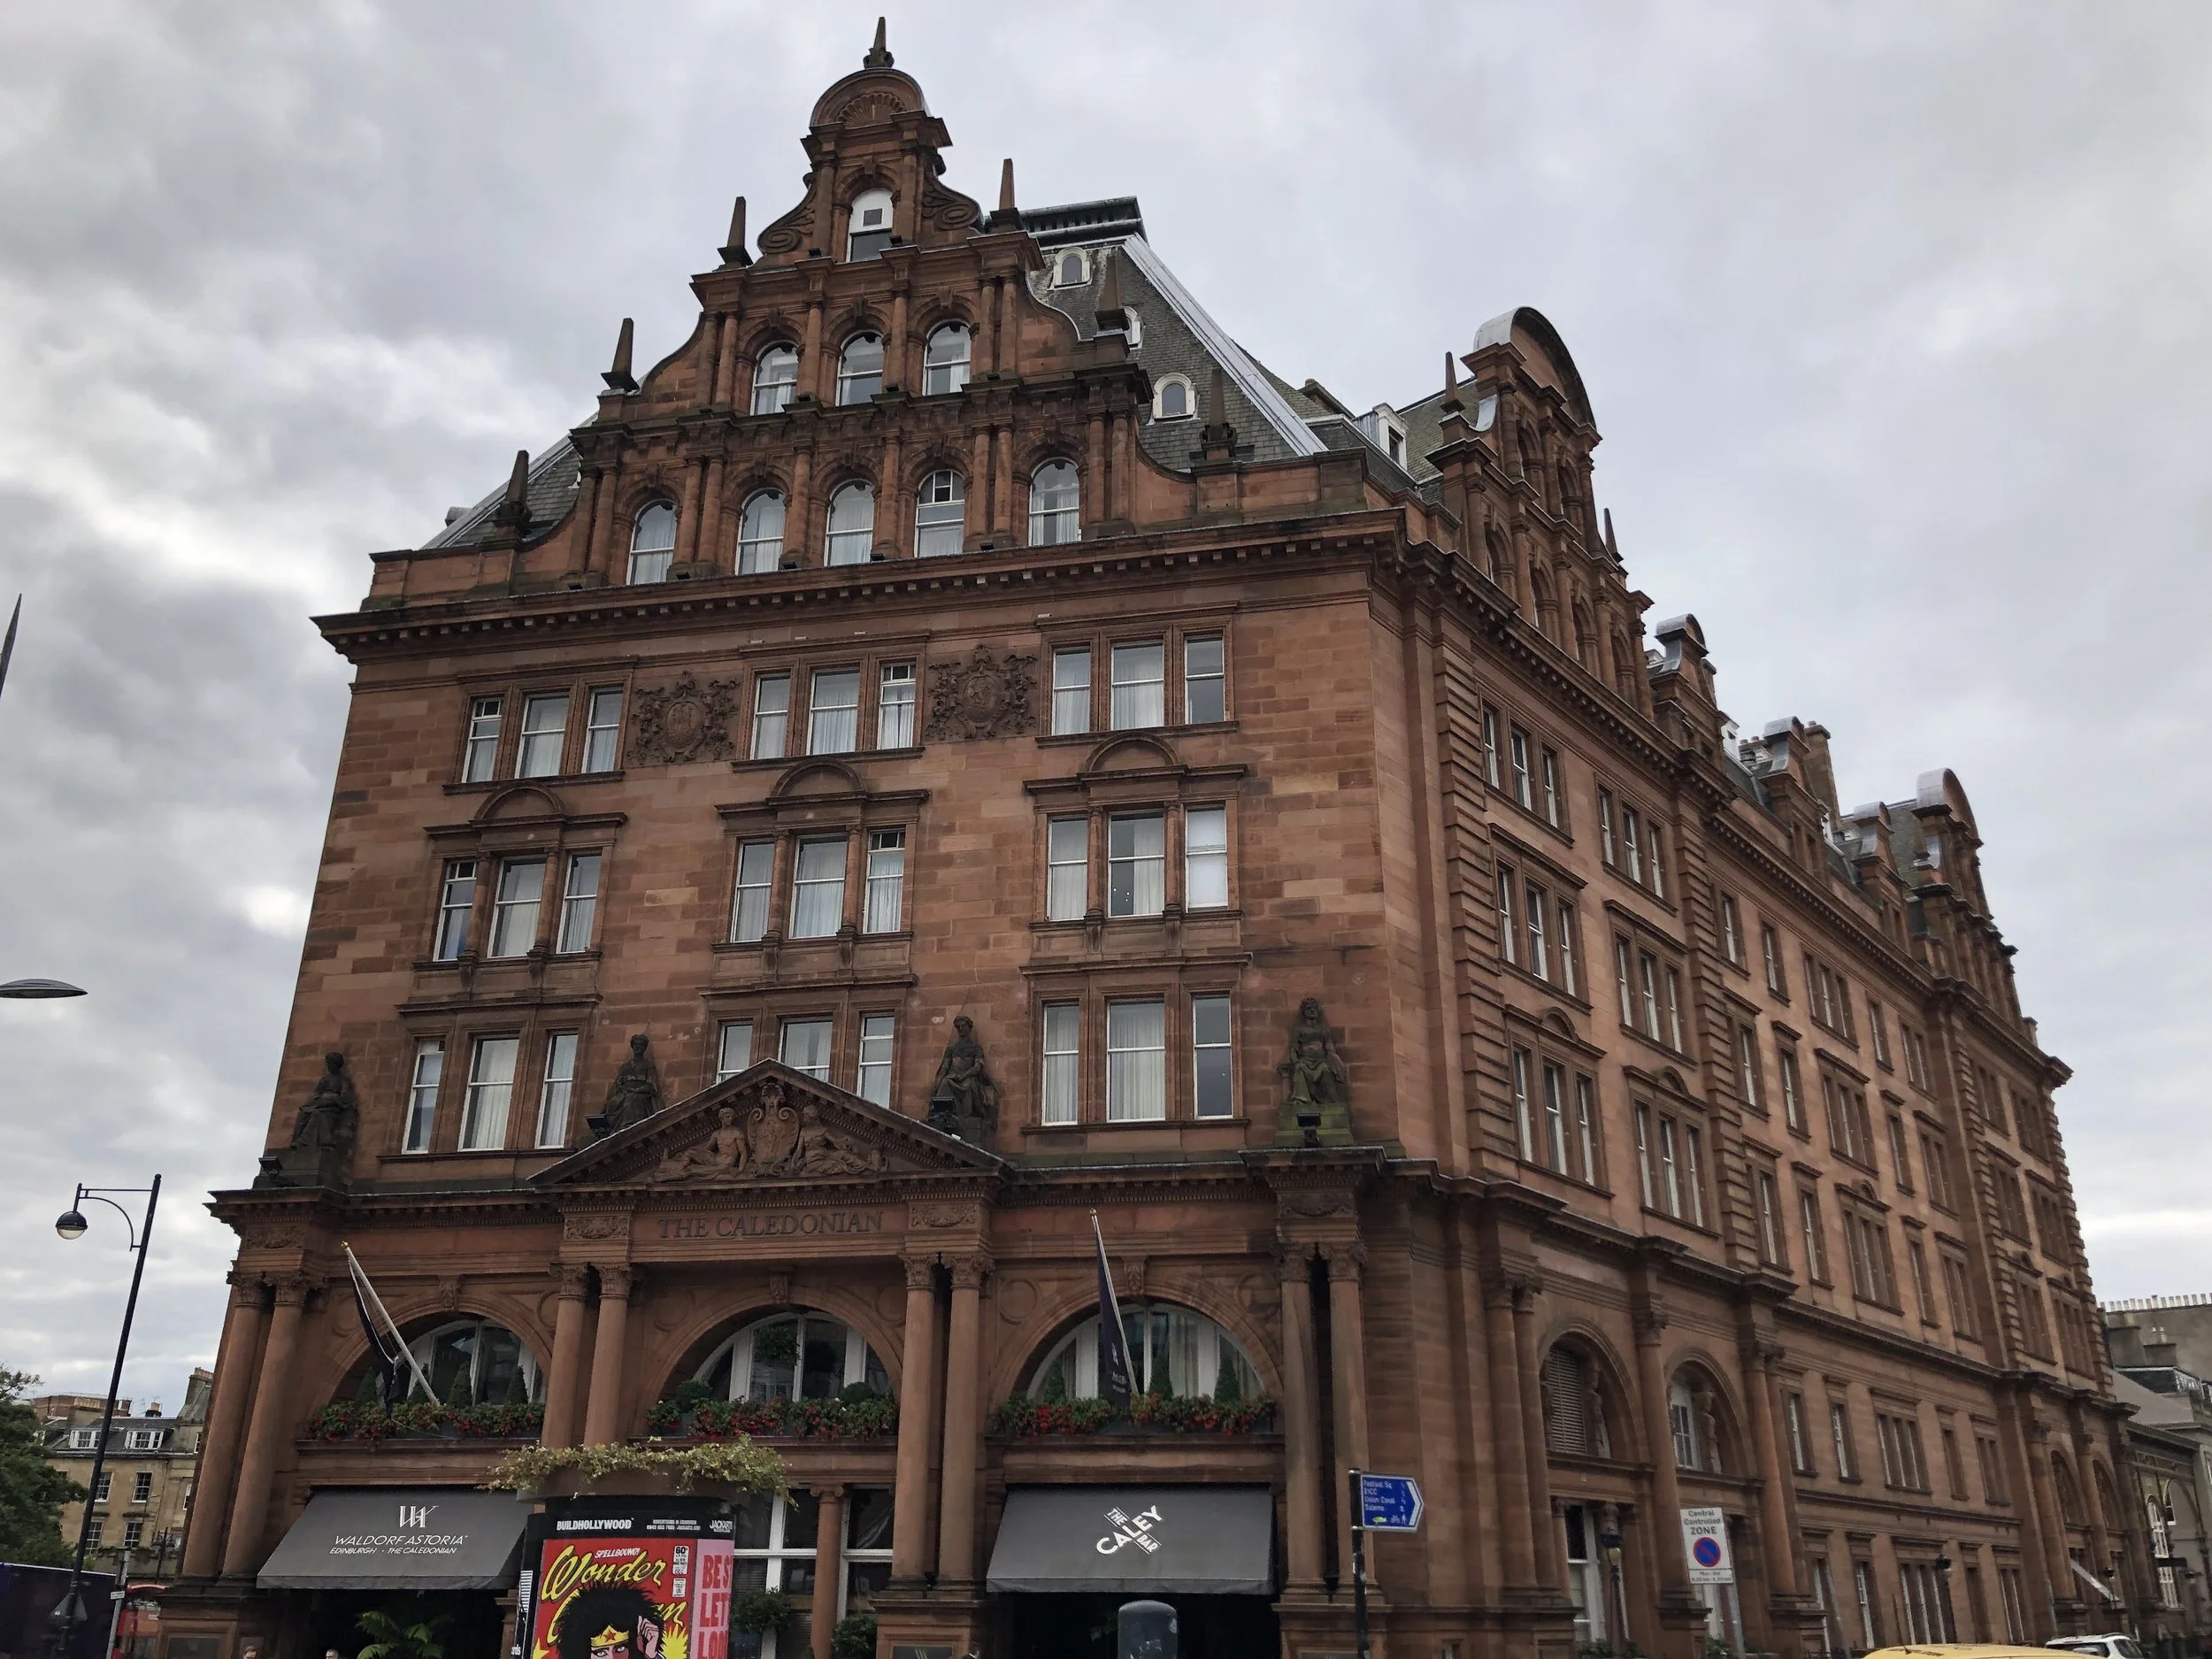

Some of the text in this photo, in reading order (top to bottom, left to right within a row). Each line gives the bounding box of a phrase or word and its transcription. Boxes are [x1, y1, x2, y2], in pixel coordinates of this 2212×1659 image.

[657, 1210, 883, 1239] THE CALEDONIAN
[557, 1519, 632, 1531] BUILDHOLLYWOOD
[1107, 1508, 1128, 1525] THE
[1096, 1505, 1163, 1555] CALEY
[1690, 1526, 1717, 1535] ZONE
[334, 1535, 464, 1546] WALDORF ASTORIA
[1136, 1534, 1158, 1552] BAR
[595, 1548, 641, 1558] SPELLBOUND!
[541, 1545, 666, 1601] Wonder
